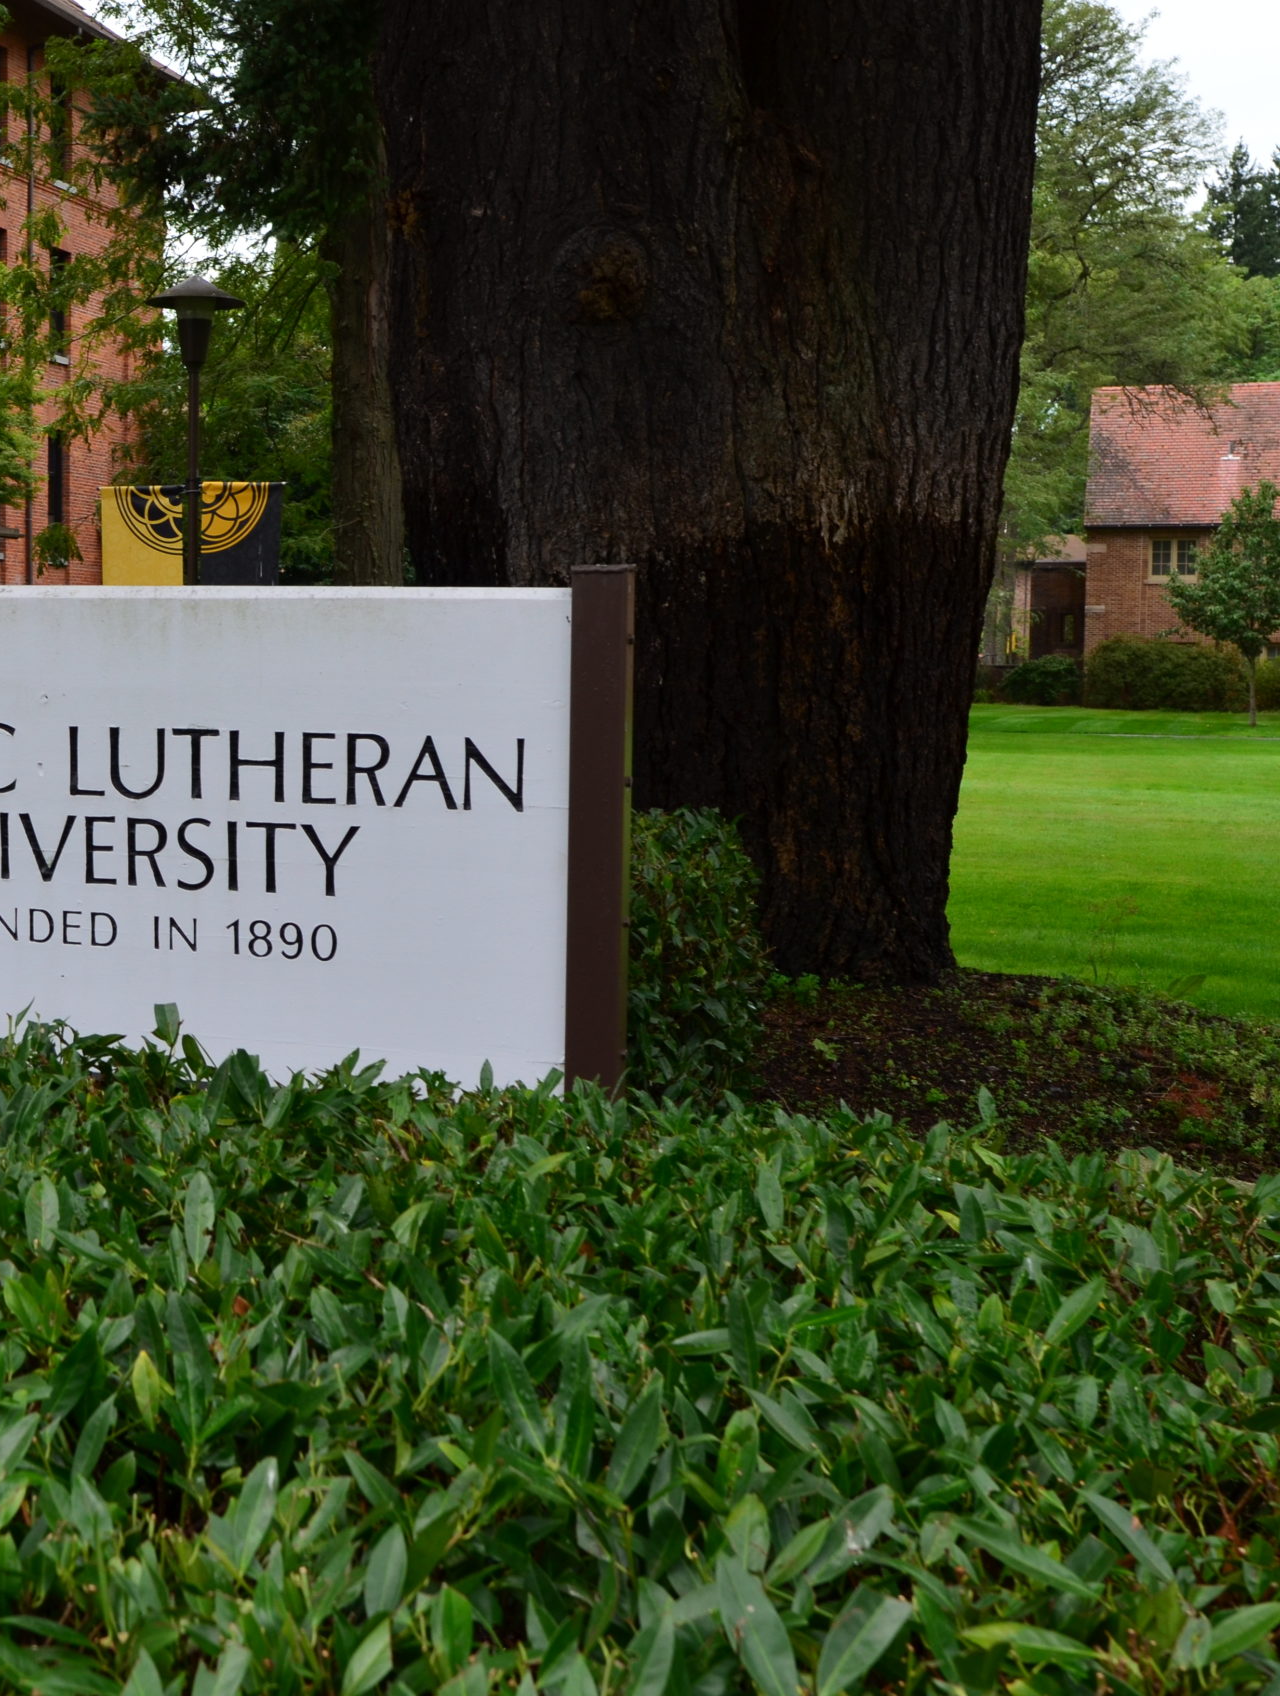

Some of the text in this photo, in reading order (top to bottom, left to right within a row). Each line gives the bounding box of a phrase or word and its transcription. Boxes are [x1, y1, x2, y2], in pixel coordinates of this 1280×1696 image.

[69, 725, 525, 813] LUTHERAN
[153, 915, 197, 952] IN
[226, 919, 338, 962] 1890
